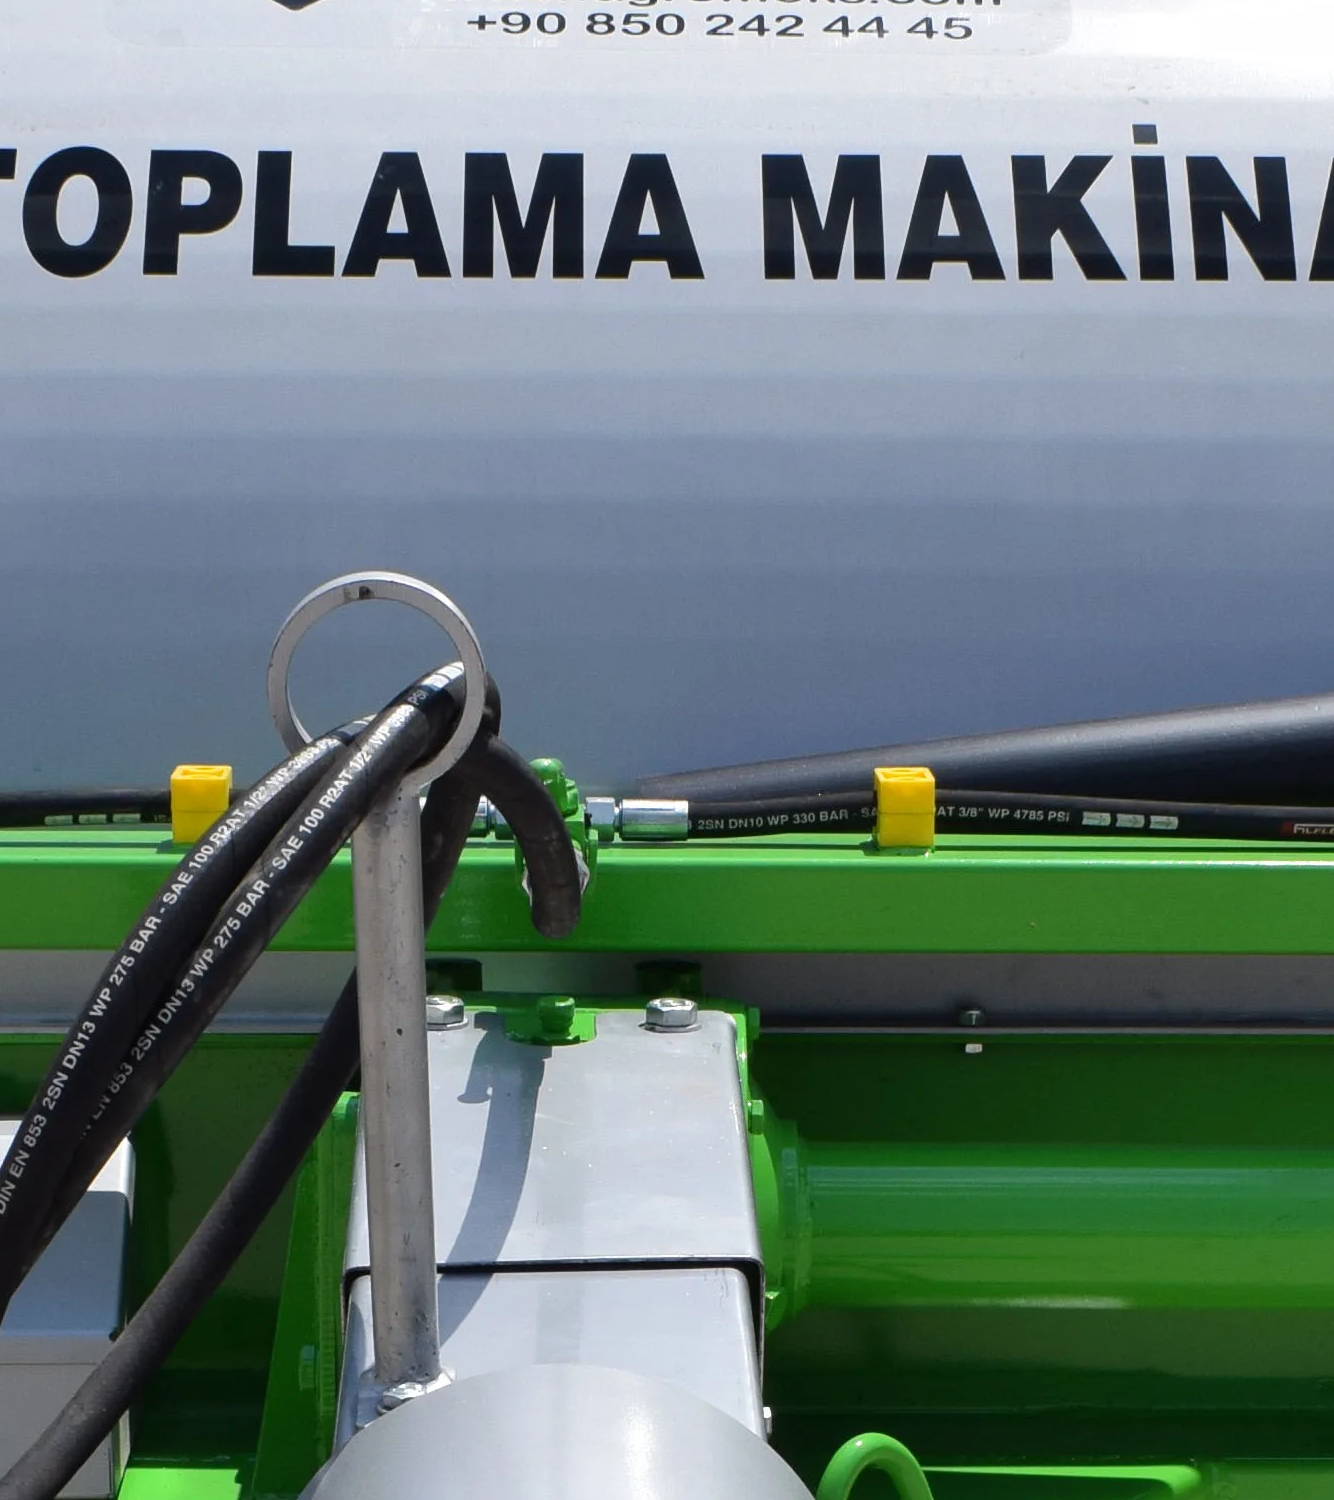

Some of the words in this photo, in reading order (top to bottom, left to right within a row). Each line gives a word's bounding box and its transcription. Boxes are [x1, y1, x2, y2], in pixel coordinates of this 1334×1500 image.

[466, 12, 567, 36] +90
[585, 12, 687, 37] 850
[705, 13, 805, 38] 242
[822, 15, 889, 39] 44
[906, 16, 974, 40] 45
[697, 818, 725, 830] 2SN
[728, 817, 763, 830] DN10
[767, 814, 789, 826] WP
[793, 812, 816, 824] 330
[820, 809, 849, 822] BAR
[861, 807, 878, 818] SA
[988, 807, 1010, 818] WP
[1014, 809, 1043, 821] 4785
[1047, 811, 1070, 822] PSI
[131, 1025, 161, 1060] 2SN
[158, 978, 196, 1024] DN13
[191, 949, 215, 977] WP
[214, 917, 241, 948] 275
[236, 878, 269, 917] BAR
[273, 836, 304, 870] SAE
[299, 808, 324, 835] 100
[319, 772, 353, 809] R2AT
[369, 726, 390, 750] WP
[9, 1150, 30, 1178] EN
[23, 1115, 47, 1147] 853
[43, 1072, 69, 1110] 2SN
[63, 1022, 96, 1070] DN13
[89, 987, 112, 1017] WP
[110, 955, 135, 986] 275
[130, 916, 162, 954] BAR
[163, 871, 194, 905] SAE
[189, 845, 214, 870] 100
[210, 808, 246, 847] R2AT
